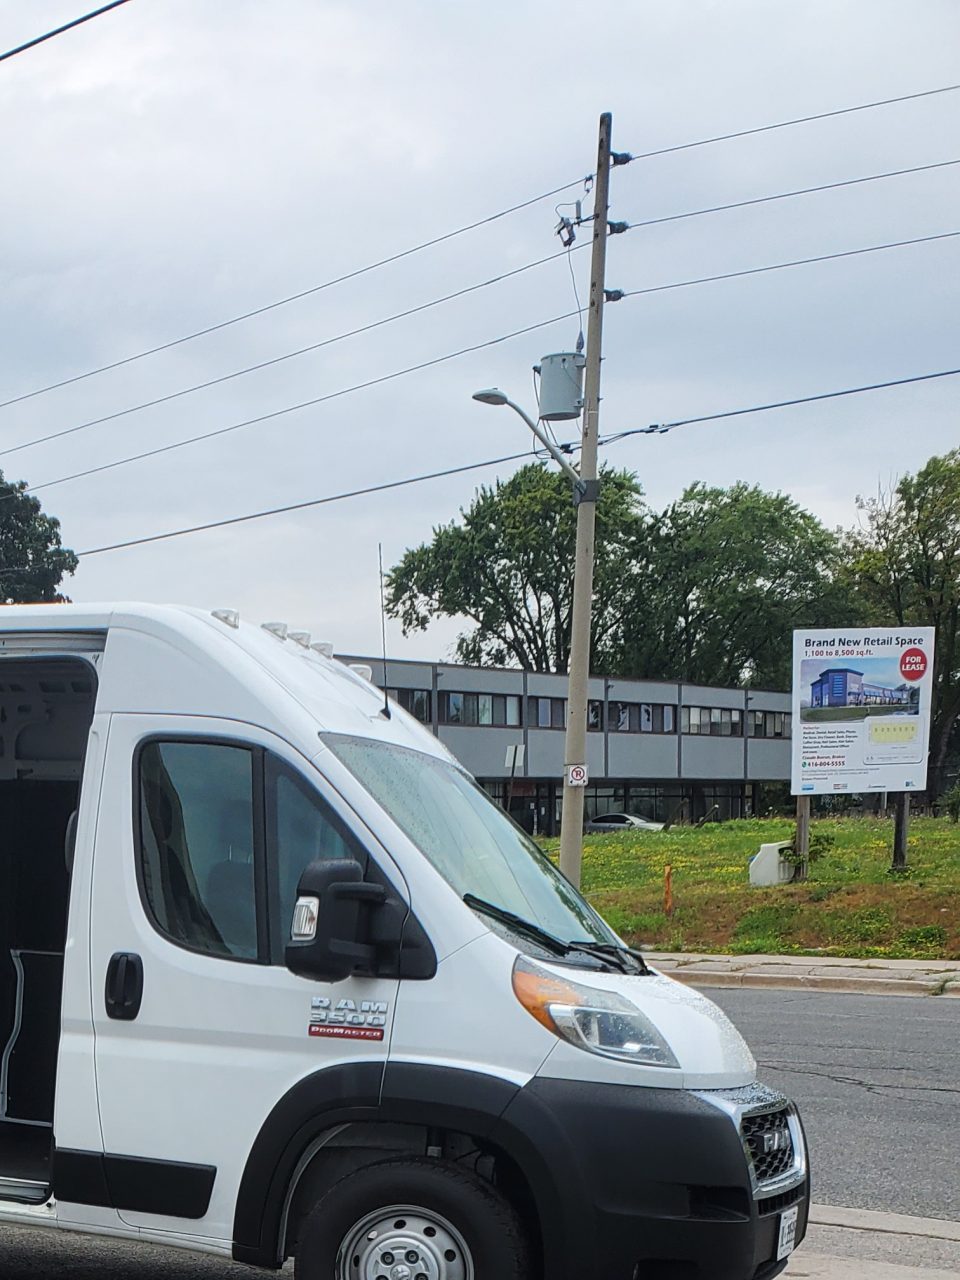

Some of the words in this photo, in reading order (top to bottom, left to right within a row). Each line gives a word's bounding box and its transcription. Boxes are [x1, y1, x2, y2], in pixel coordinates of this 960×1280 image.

[804, 638, 835, 647] Brand
[838, 637, 862, 647] New
[863, 636, 892, 646] Retail
[895, 636, 924, 647] Space
[835, 649, 855, 657] 8,500
[902, 663, 925, 671] LEASE
[311, 997, 388, 1014] RAM
[309, 1011, 386, 1027] 3500
